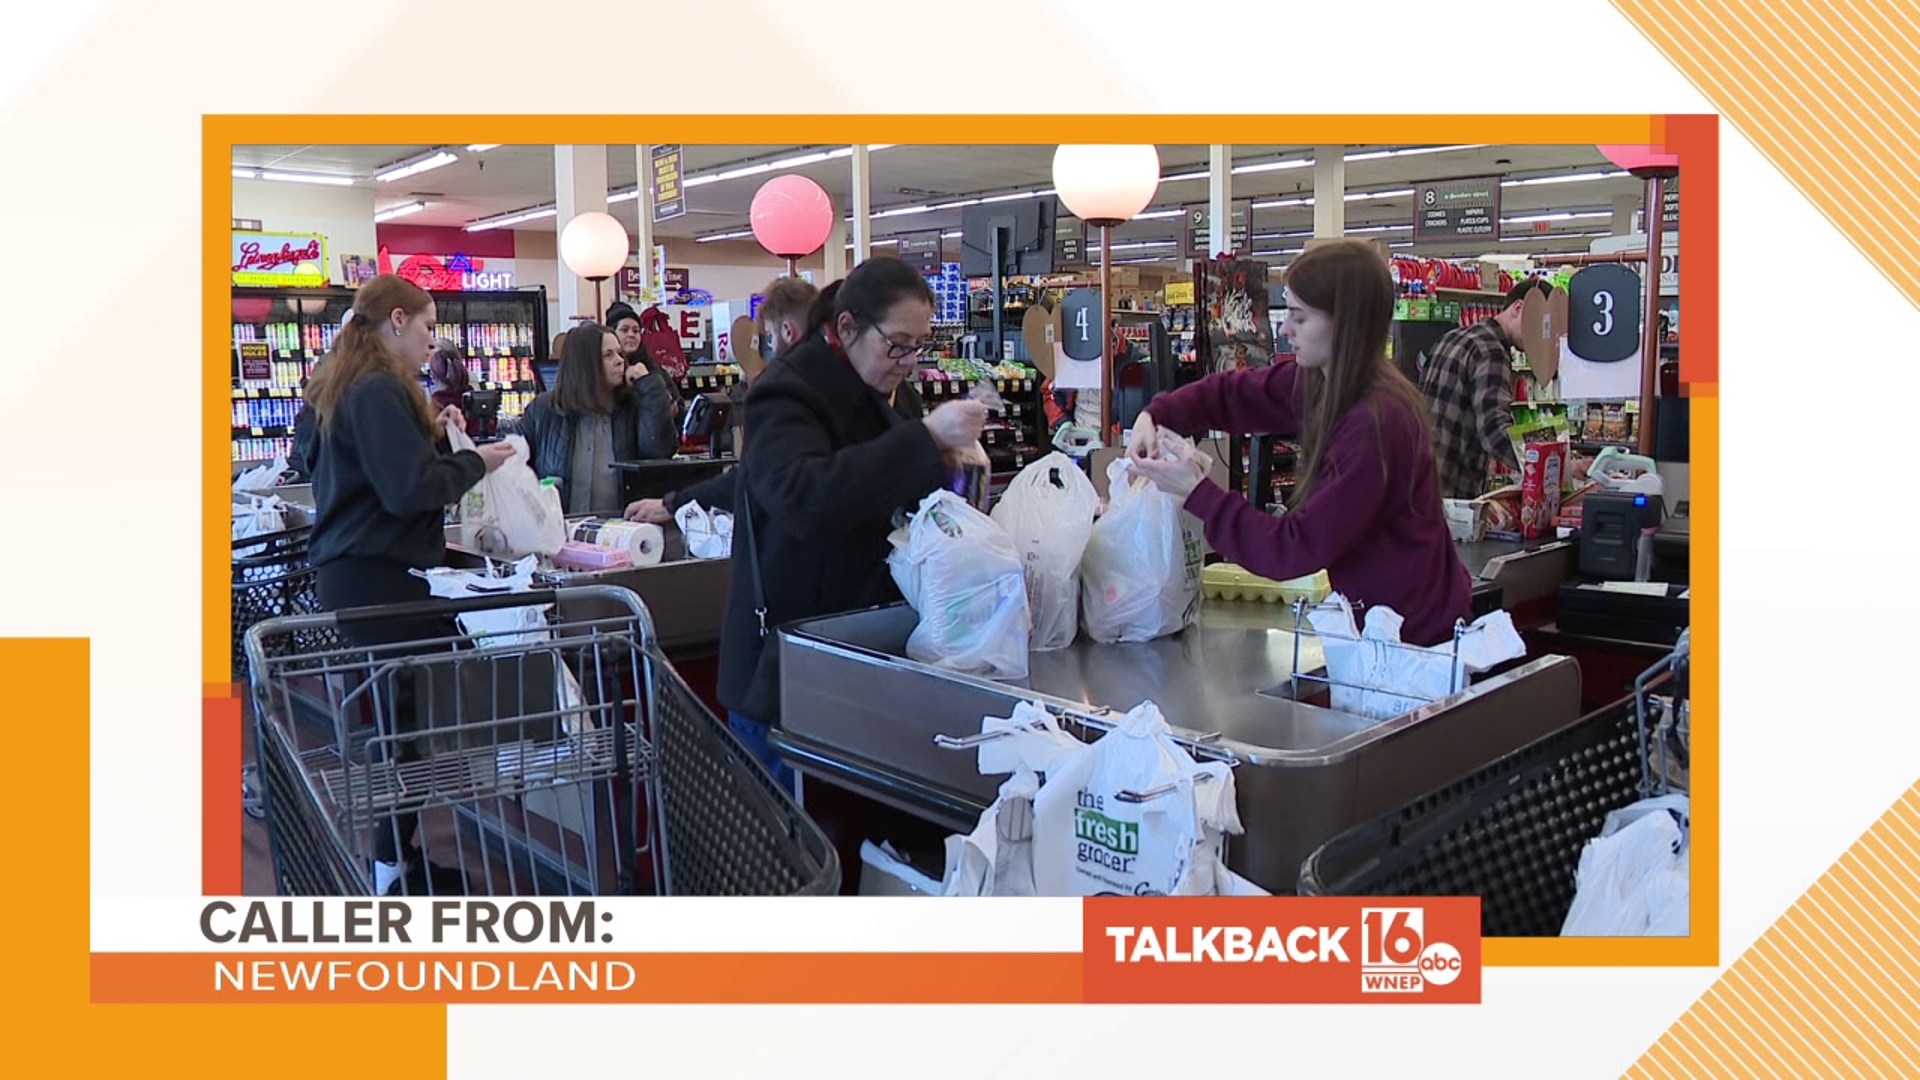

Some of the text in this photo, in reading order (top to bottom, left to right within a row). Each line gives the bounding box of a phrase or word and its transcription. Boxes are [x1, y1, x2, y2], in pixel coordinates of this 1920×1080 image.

[1425, 191, 1435, 204] 8
[1193, 211, 1203, 223] 9
[461, 272, 512, 289] LIGHT
[1075, 306, 1090, 341] 4
[1592, 290, 1613, 336] 3
[1077, 787, 1104, 811] the
[1075, 810, 1137, 852] fresh
[1077, 841, 1133, 873] grocer
